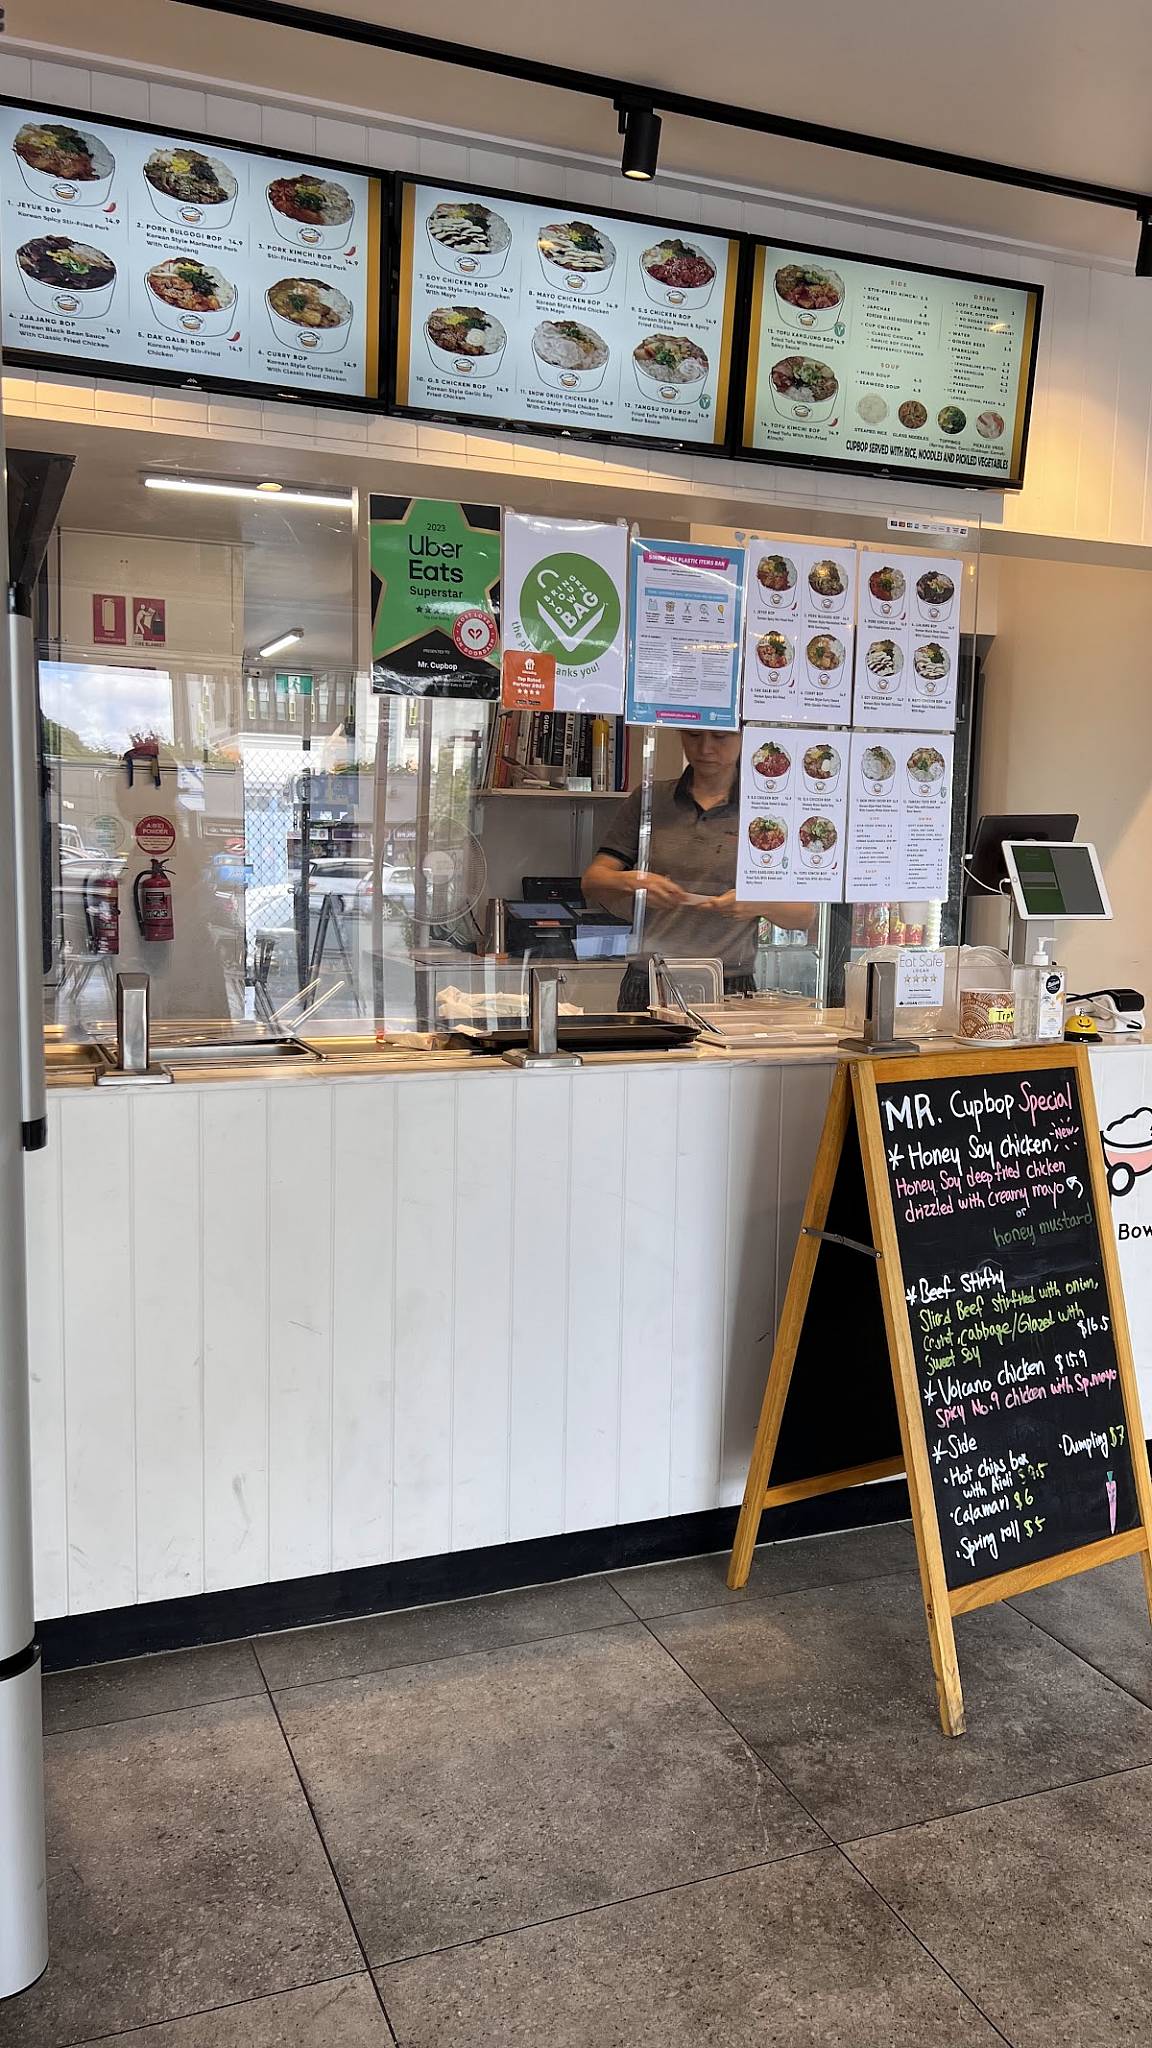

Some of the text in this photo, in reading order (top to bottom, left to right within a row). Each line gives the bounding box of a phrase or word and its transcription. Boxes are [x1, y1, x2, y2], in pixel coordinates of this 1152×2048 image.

[16, 201, 42, 210] JEYUK
[17, 210, 42, 219] Korean
[42, 215, 61, 223] Spicy
[146, 223, 167, 232] PORK
[169, 227, 204, 238] BULGOGI
[266, 244, 286, 253] PORK
[289, 248, 315, 257] KIMCHI
[441, 276, 472, 286] CHICKEN
[536, 291, 555, 299] MAYO
[556, 294, 586, 303] CHICKEN
[19, 314, 57, 324] JJAJANG
[649, 309, 677, 317] CHICKEN
[84, 331, 106, 339] Sauce
[146, 332, 163, 340] DAK
[266, 350, 290, 358] CURRY
[880, 362, 900, 370] SOUP
[440, 379, 471, 387] CHICKEN
[563, 394, 587, 402] CHICKEN
[845, 439, 1011, 471] CUPBOP SERVED WITH RICE, NOODLES AND PICKLED VEGETABLES
[427, 522, 446, 533] 2023
[408, 534, 463, 559] Uber
[408, 559, 464, 583] Eats
[409, 585, 463, 599] Superstar
[544, 575, 576, 603] BRING
[548, 580, 583, 608] YOUR
[555, 585, 587, 615] OWN
[560, 592, 599, 629] BAG
[457, 613, 494, 629] MOST LOVED
[511, 621, 522, 640] the
[418, 661, 458, 671] Mr. Cupbop
[580, 663, 600, 678] you!
[899, 954, 943, 968] Eat Safe
[884, 1081, 1073, 1132] MR. Cupbop Special
[1055, 1125, 1074, 1139] New
[908, 1133, 1052, 1176] Honey Soy chicken
[896, 1158, 1066, 1199] Honey Soy deep fried chicken
[905, 1181, 1065, 1223] drizzled with creamy mayo
[1015, 1207, 1027, 1219] or
[993, 1202, 1093, 1247] honey mustard
[919, 1274, 955, 1304] Beef
[956, 1295, 984, 1321] Beef
[1038, 1281, 1062, 1299] with
[1058, 1302, 1086, 1322] with
[1076, 1315, 1109, 1339] $16.5
[937, 1375, 992, 1406] Volcano
[997, 1357, 1047, 1386] chicken
[936, 1404, 966, 1428] Spicy
[1005, 1385, 1047, 1409] chicken
[1050, 1376, 1074, 1397] with
[947, 1432, 978, 1459] Side
[1062, 1424, 1125, 1459] Dumpling $7
[949, 1450, 1030, 1486] Hot chips box
[962, 1481, 988, 1499] with
[991, 1471, 1014, 1494] Aioli
[953, 1488, 1034, 1526] Calamari $6
[960, 1515, 1047, 1568] Spring roll $5
